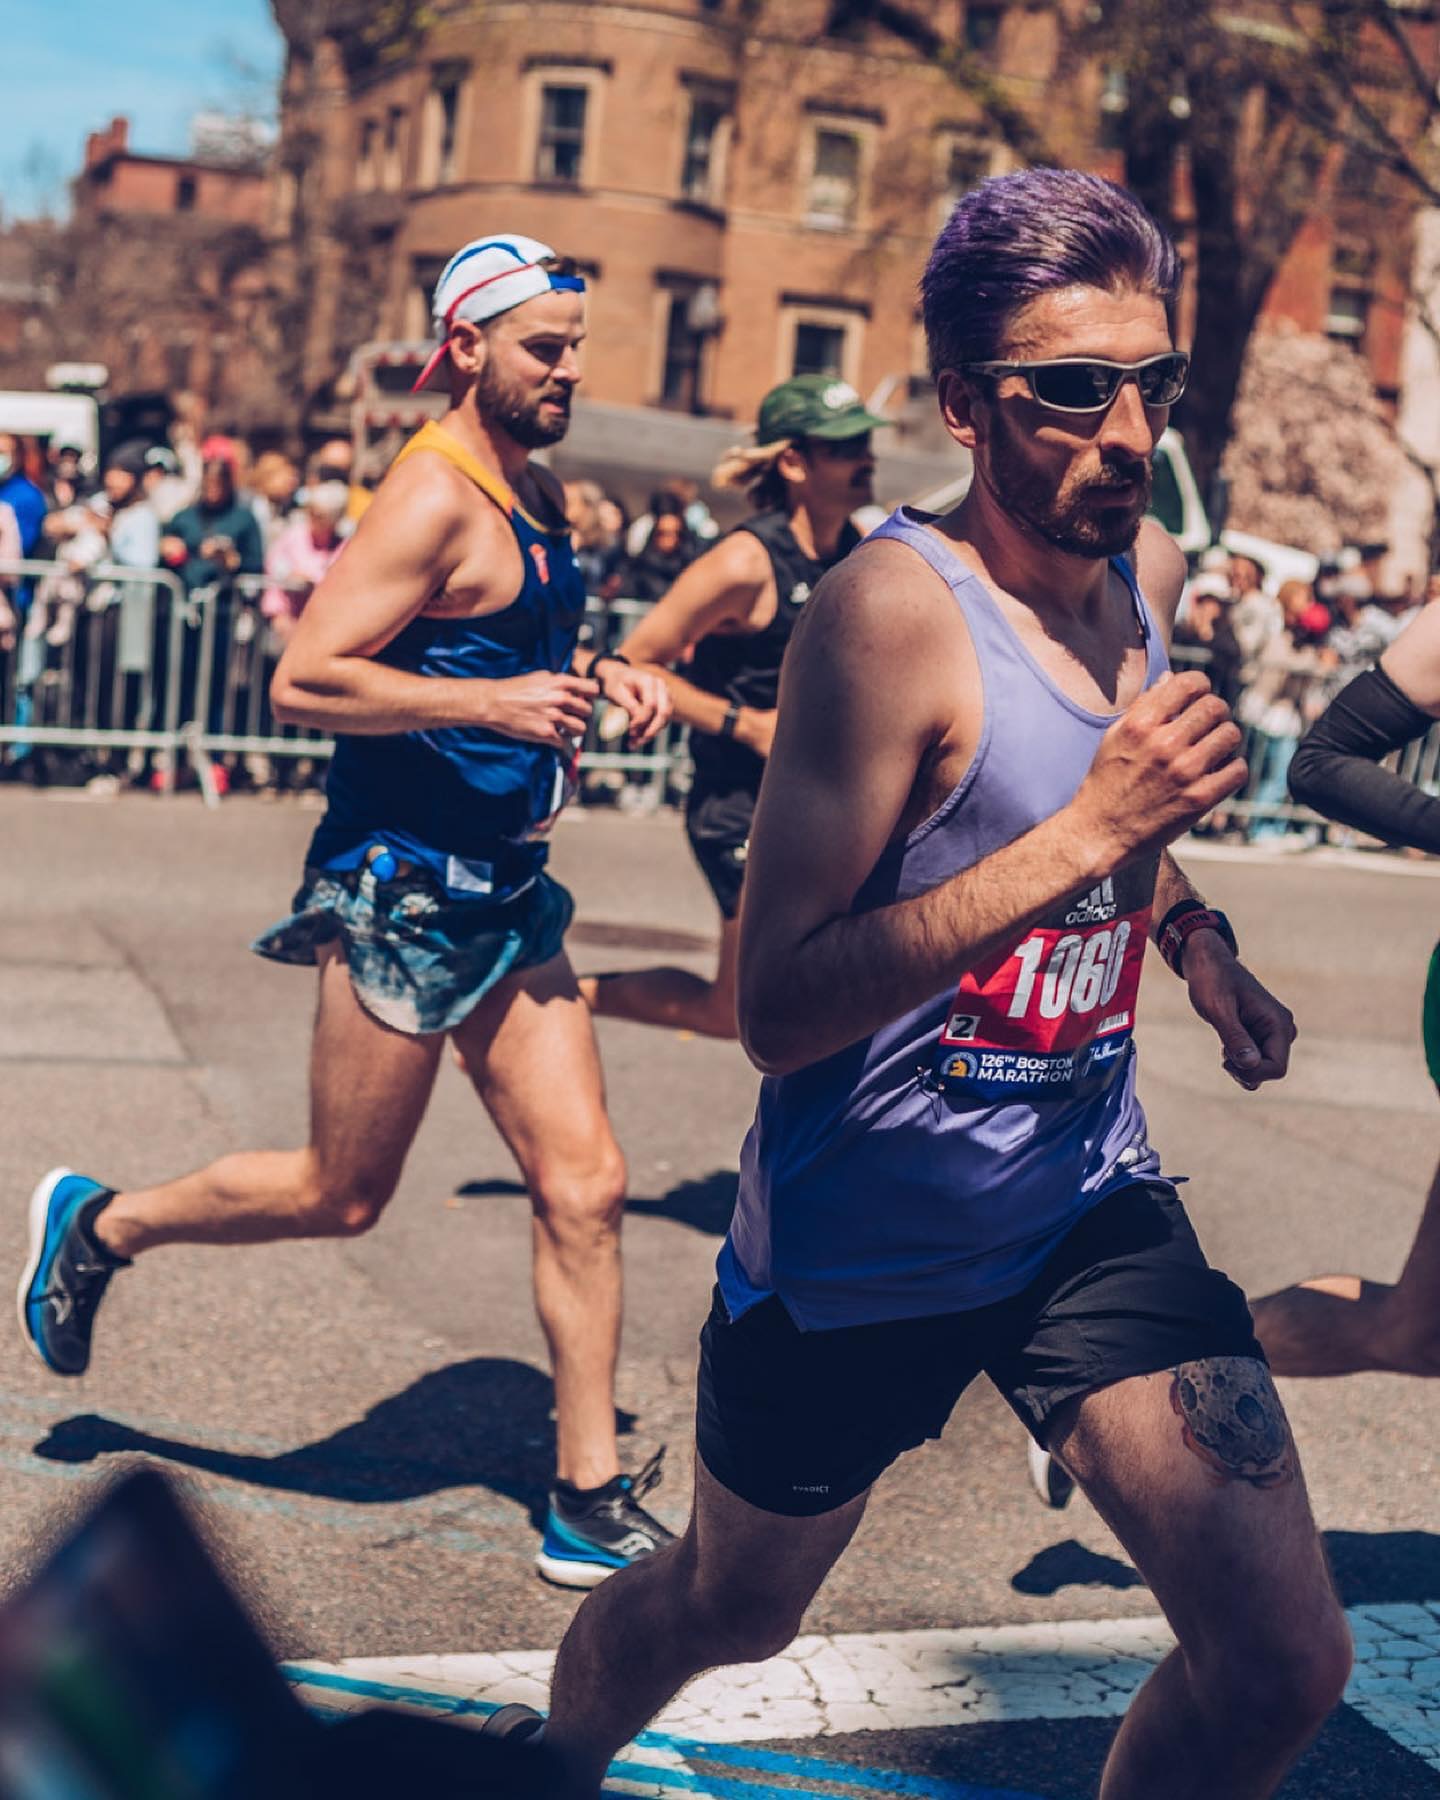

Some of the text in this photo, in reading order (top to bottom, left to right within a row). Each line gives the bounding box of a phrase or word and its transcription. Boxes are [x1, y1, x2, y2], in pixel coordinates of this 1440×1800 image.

[1065, 904, 1117, 925] adidas
[1008, 921, 1131, 1019] 1060
[951, 1016, 974, 1038] 2
[981, 1054, 1015, 1067] 126TH
[1016, 1057, 1072, 1069] BOSTON
[977, 1068, 1072, 1082] MARATHON
